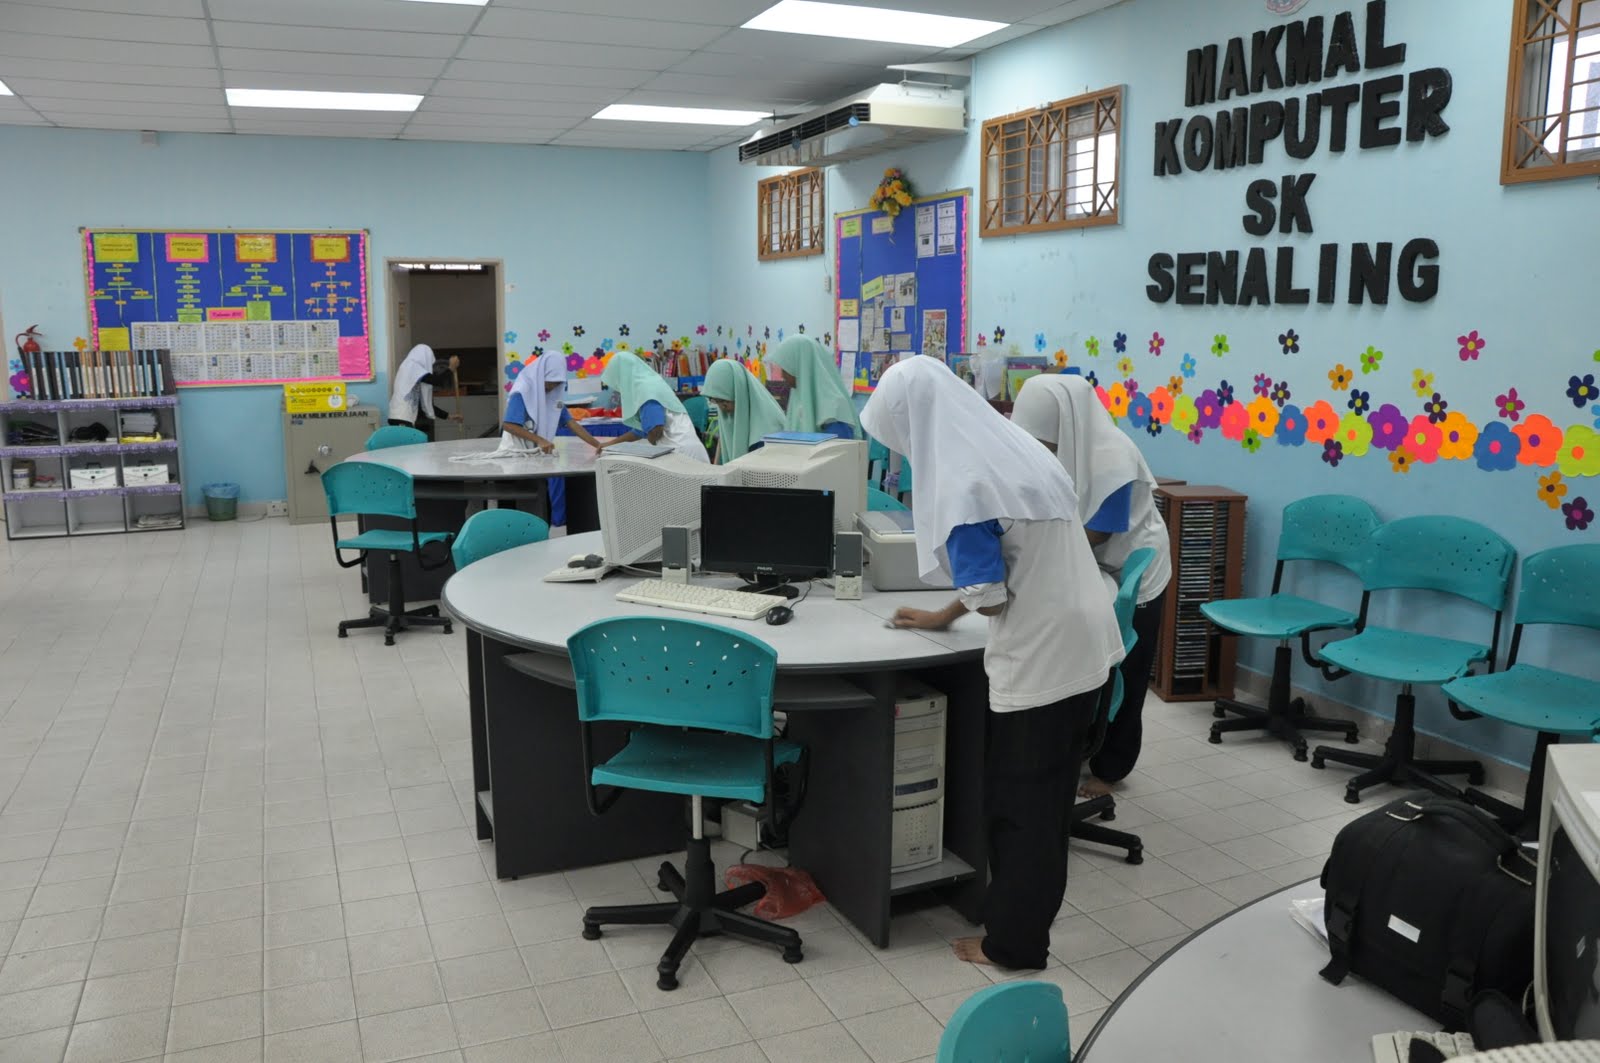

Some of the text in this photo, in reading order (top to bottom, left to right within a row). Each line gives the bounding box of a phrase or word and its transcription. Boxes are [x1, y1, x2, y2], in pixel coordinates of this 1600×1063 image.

[1185, 0, 1407, 107] MAKMAL
[1154, 67, 1453, 176] KOMPUTER
[1242, 173, 1316, 236] SK
[1146, 238, 1440, 306] SENALING
